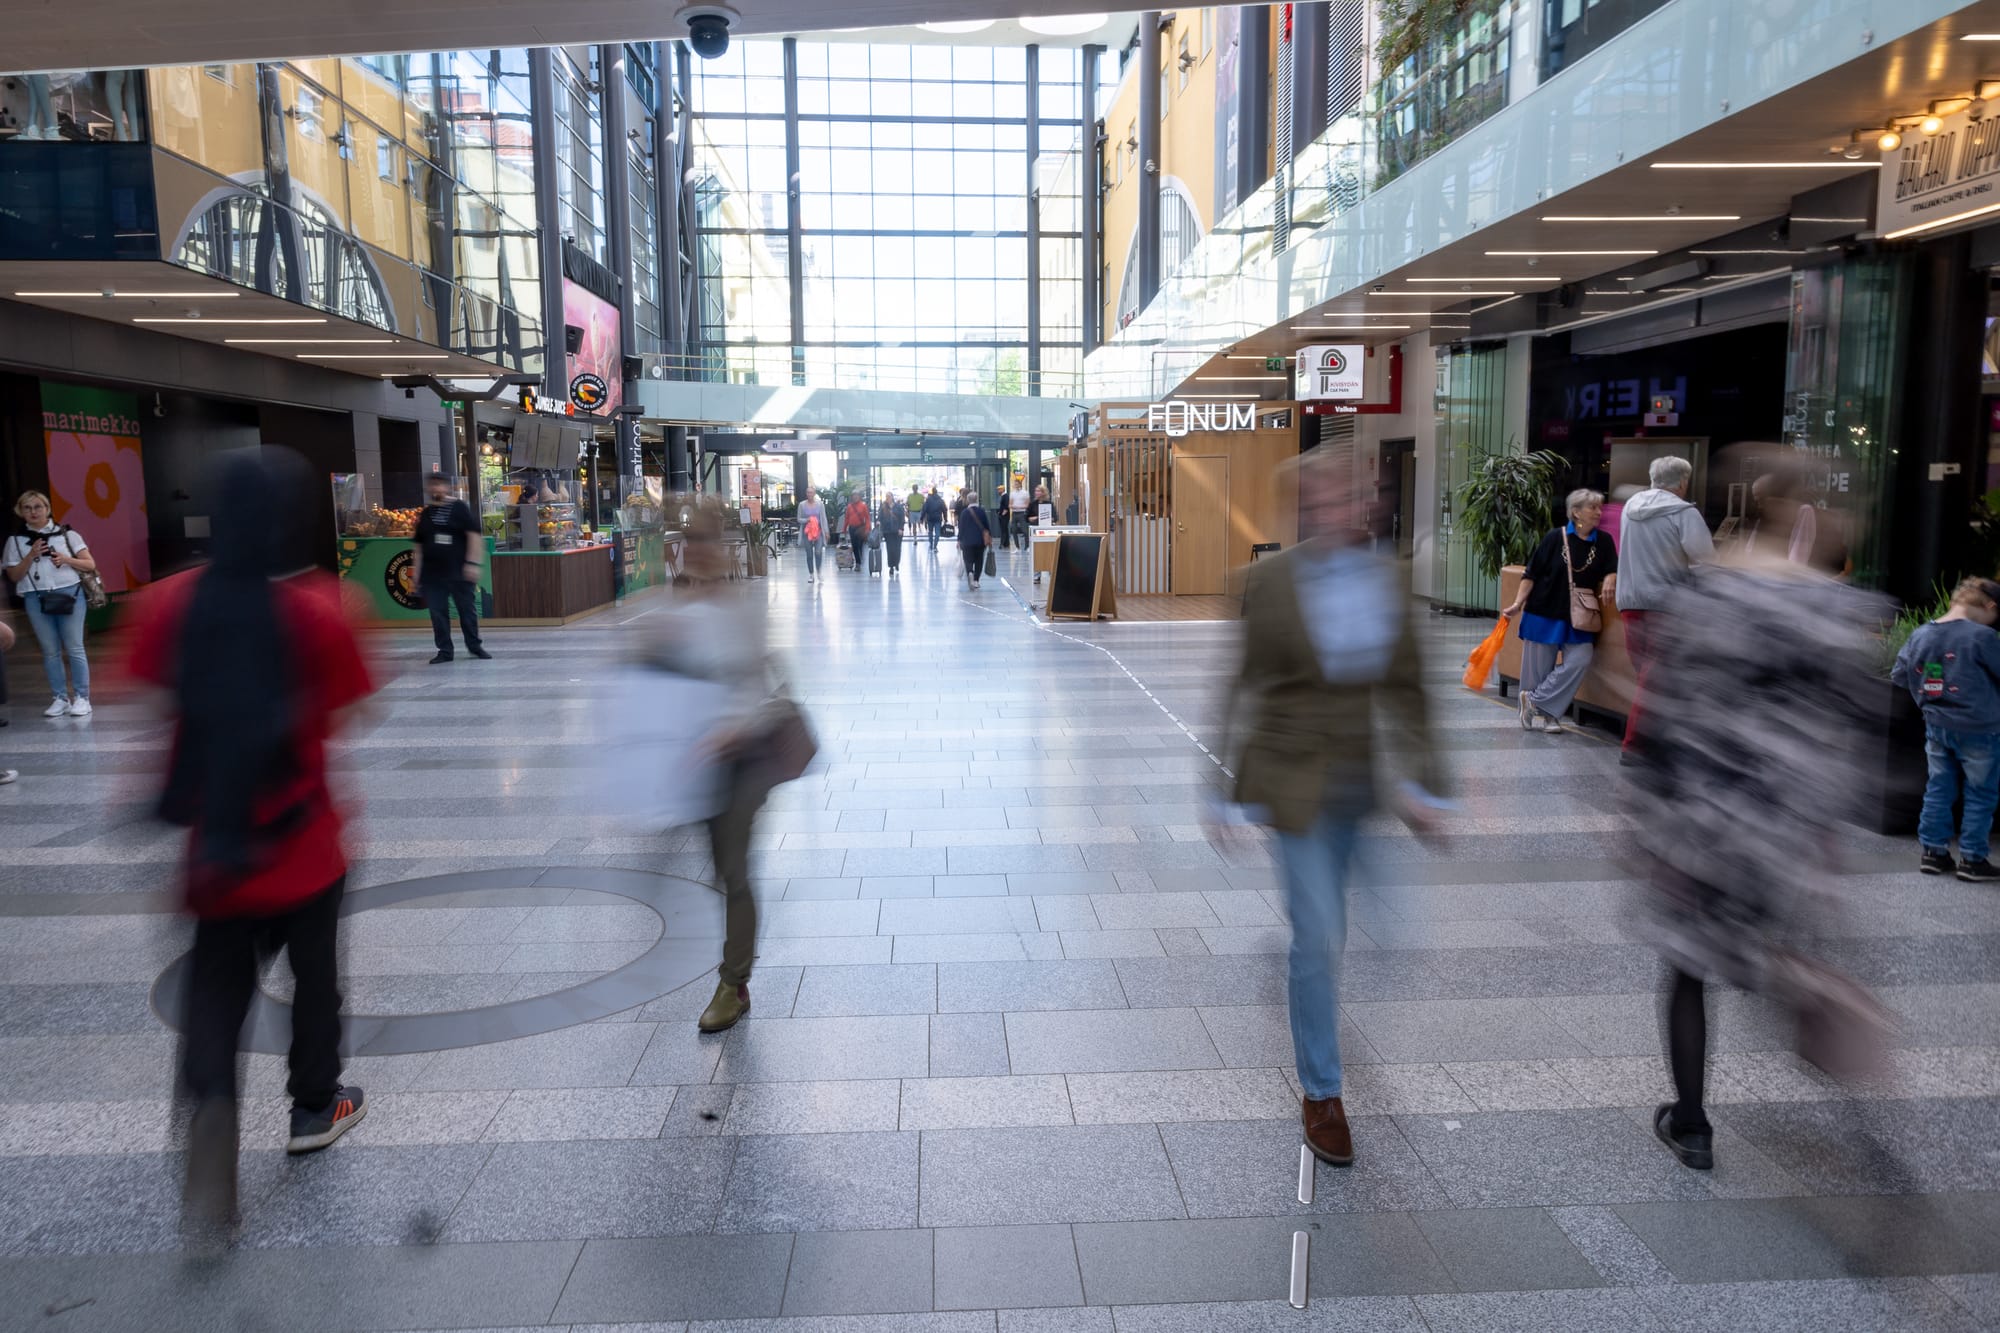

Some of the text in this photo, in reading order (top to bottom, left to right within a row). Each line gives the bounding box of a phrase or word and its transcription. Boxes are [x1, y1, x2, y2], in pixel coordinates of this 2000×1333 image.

[42, 411, 141, 435] marimekko
[1148, 400, 1256, 437] FONUM
[388, 553, 409, 575] JUNGLE
